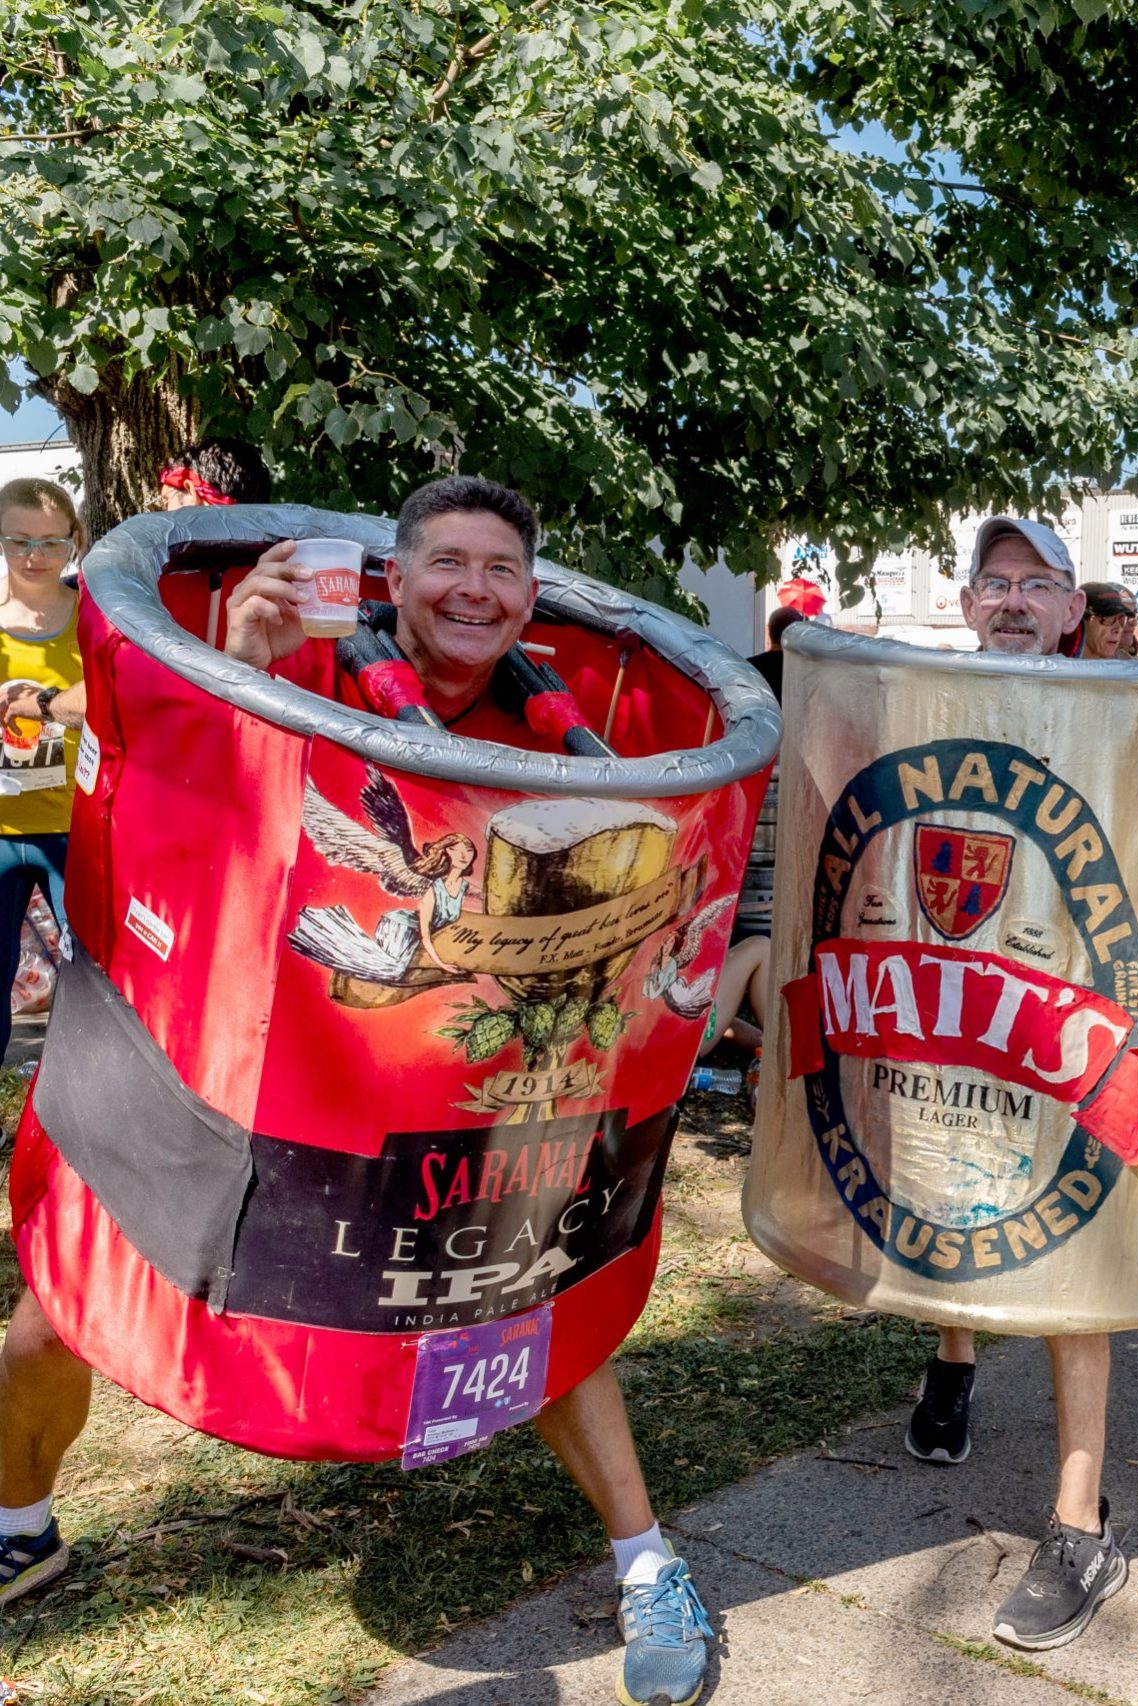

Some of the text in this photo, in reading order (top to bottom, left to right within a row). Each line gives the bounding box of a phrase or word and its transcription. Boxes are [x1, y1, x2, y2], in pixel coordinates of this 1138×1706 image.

[319, 575, 360, 598] SARAN
[824, 752, 1132, 965] ALL NATURAL
[488, 931, 534, 956] legacy
[538, 926, 563, 952] of
[554, 917, 598, 951] great
[598, 911, 622, 931] beer
[624, 898, 651, 919] lives
[1005, 933, 1055, 959] Established
[1112, 959, 1128, 1008] GRAINS
[816, 952, 1128, 1085] MATT'S
[502, 1073, 576, 1096] 1914
[873, 1062, 1035, 1120] PREMIUM
[919, 1107, 979, 1129] LAGER
[413, 1130, 605, 1220] SARANAC
[822, 1125, 1103, 1271] KRAUSENED
[331, 1178, 626, 1262] LEGACY
[378, 1246, 578, 1306] IPA
[394, 1281, 559, 1326] INDIA PALE ALE
[500, 1317, 541, 1346] SARANAC
[442, 1346, 530, 1410] 7424
[1080, 1550, 1105, 1593] HOKA
